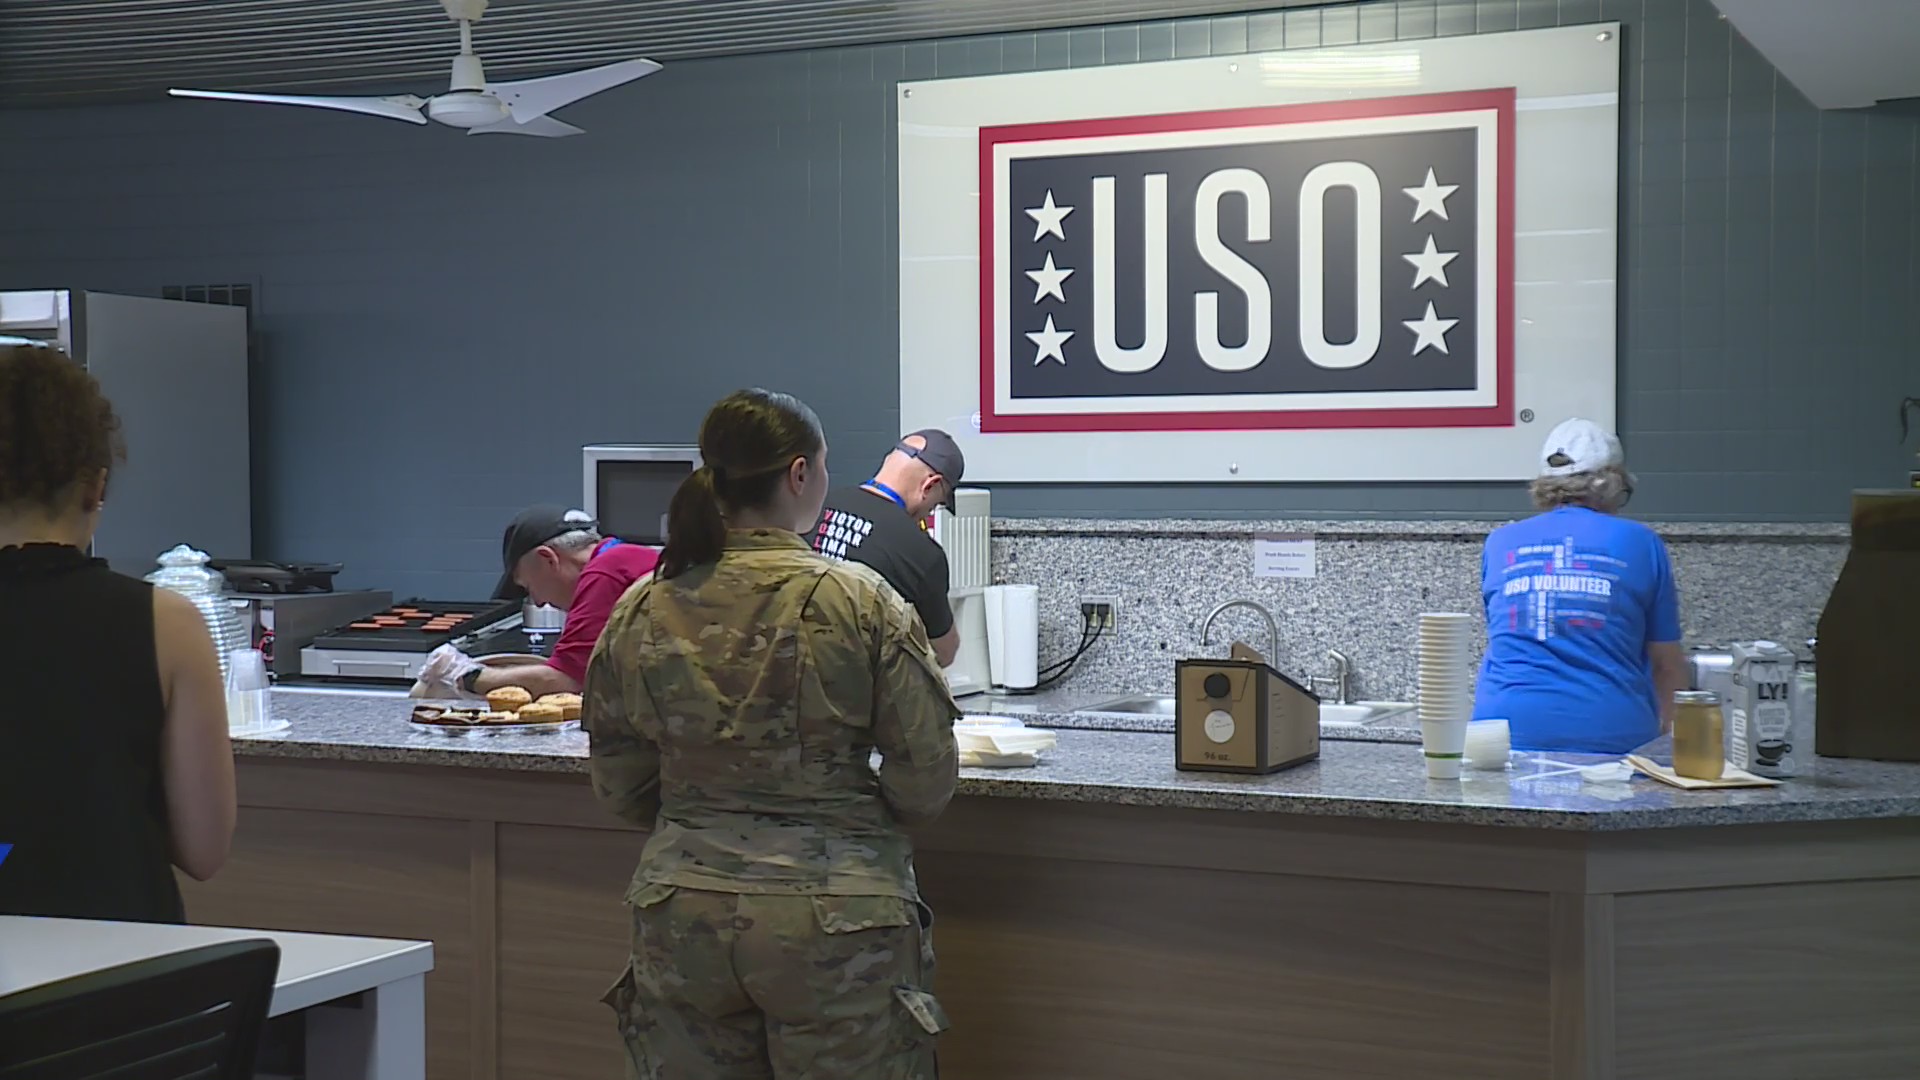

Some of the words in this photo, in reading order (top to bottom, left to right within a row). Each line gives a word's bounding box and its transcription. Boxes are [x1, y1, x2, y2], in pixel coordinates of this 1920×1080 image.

[1092, 160, 1382, 374] USO
[813, 535, 847, 556] LIMA
[1503, 575, 1530, 596] USO
[1534, 575, 1612, 596] VOLUNTEER
[1758, 682, 1788, 700] LY!
